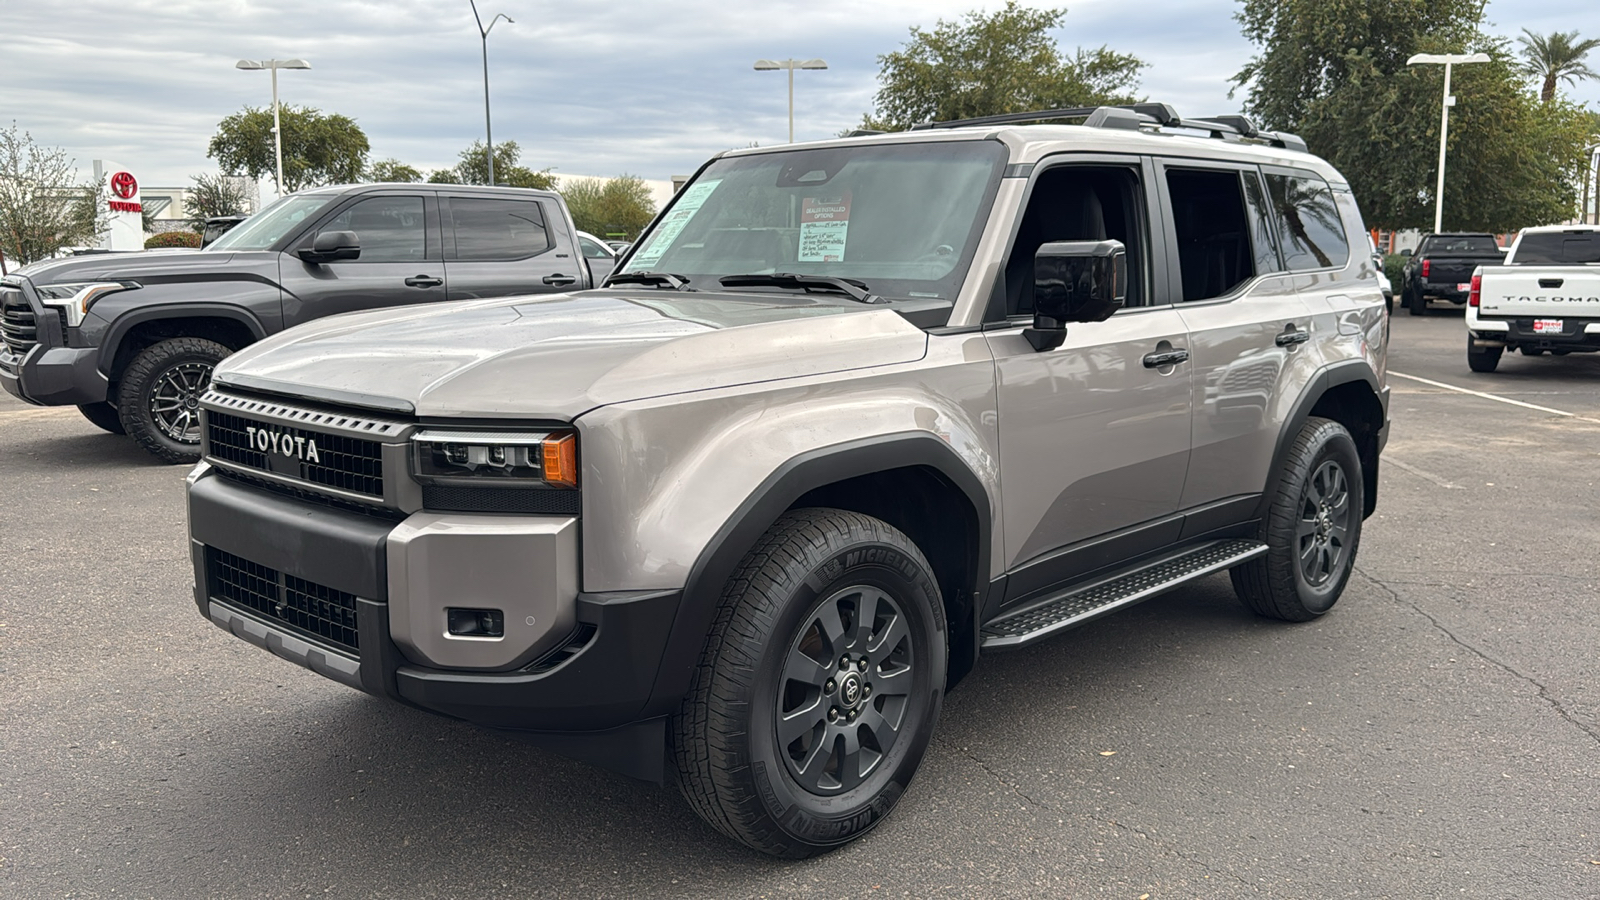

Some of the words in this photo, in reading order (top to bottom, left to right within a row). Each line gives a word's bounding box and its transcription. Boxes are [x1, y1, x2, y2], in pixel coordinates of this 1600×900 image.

[108, 200, 142, 213] TOYOTA
[246, 426, 320, 463] TOYOTA
[845, 548, 918, 578] MICHELIN
[788, 808, 872, 838] MICHELIN
